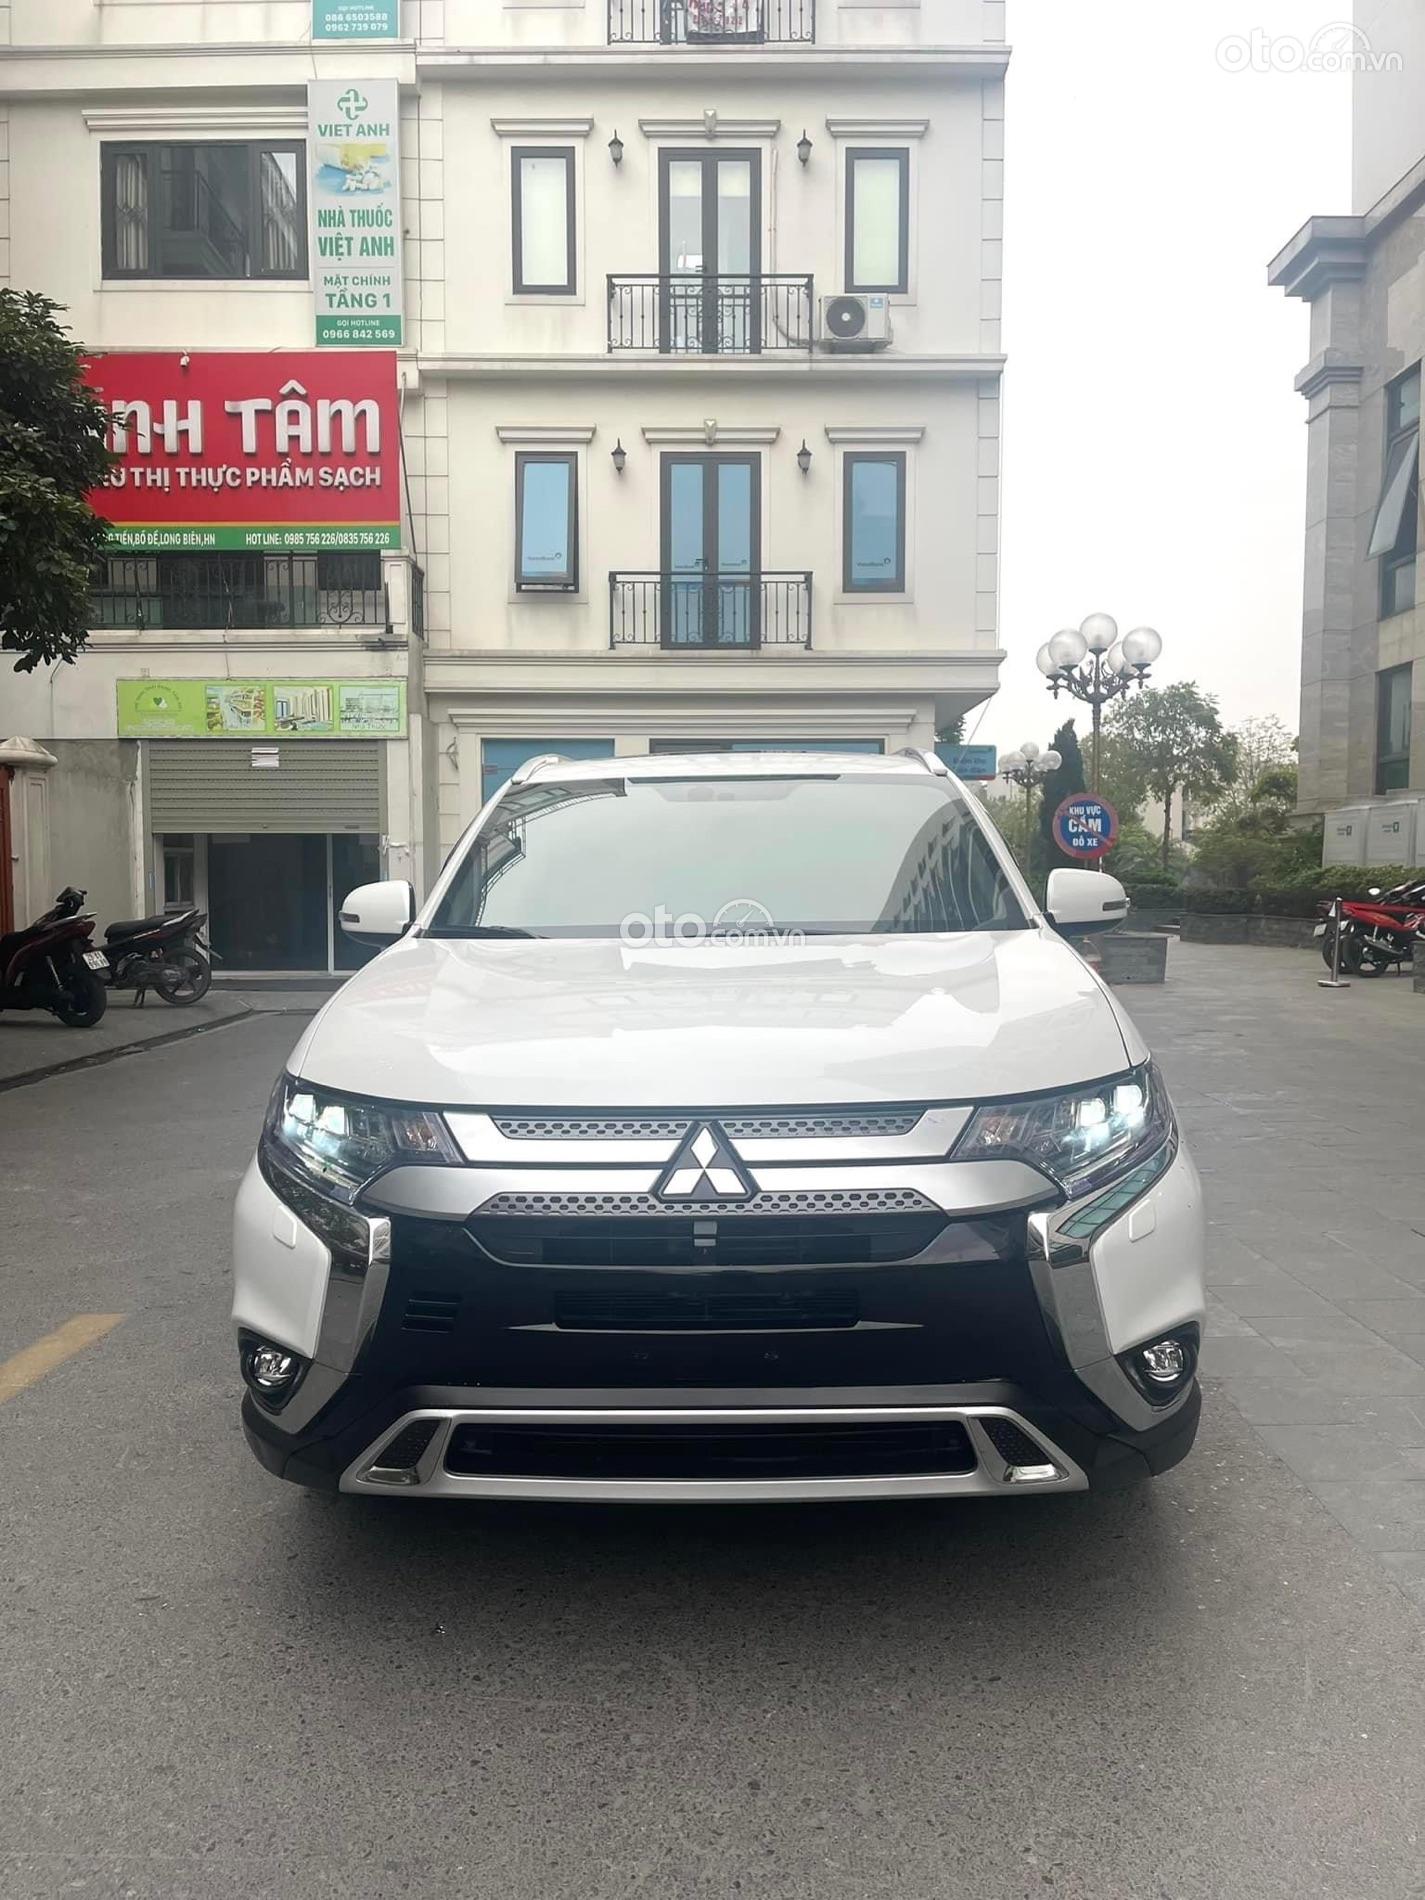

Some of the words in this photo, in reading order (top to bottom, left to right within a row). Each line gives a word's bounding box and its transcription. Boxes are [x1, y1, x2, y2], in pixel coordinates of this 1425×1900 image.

[318, 124, 352, 136] VIET
[356, 123, 390, 136] ANH
[318, 205, 346, 228] NHÀ
[349, 202, 393, 228] THUỐC
[318, 232, 354, 261] VIỆT
[359, 236, 395, 256] ANH
[323, 274, 349, 288] MẶT
[352, 274, 391, 286] CHÍNH
[325, 287, 377, 308] TẦNG
[382, 293, 391, 308] 1
[322, 329, 350, 338] 0966
[352, 329, 373, 338] 842
[375, 329, 395, 338] 569
[224, 379, 380, 454] TÂM
[129, 467, 170, 492] THỊ
[175, 464, 242, 492] THỰC
[245, 457, 314, 487] PHẨM
[318, 466, 381, 491] SẠCH
[245, 533, 263, 545] HOT
[263, 533, 282, 545] LINE:
[284, 532, 304, 545] 0985
[306, 532, 320, 545] 756
[359, 532, 374, 544] 756
[375, 532, 390, 544] 226
[1069, 806, 1085, 815] KHU
[1086, 805, 1102, 816] VỰC
[1087, 838, 1098, 847] XE
